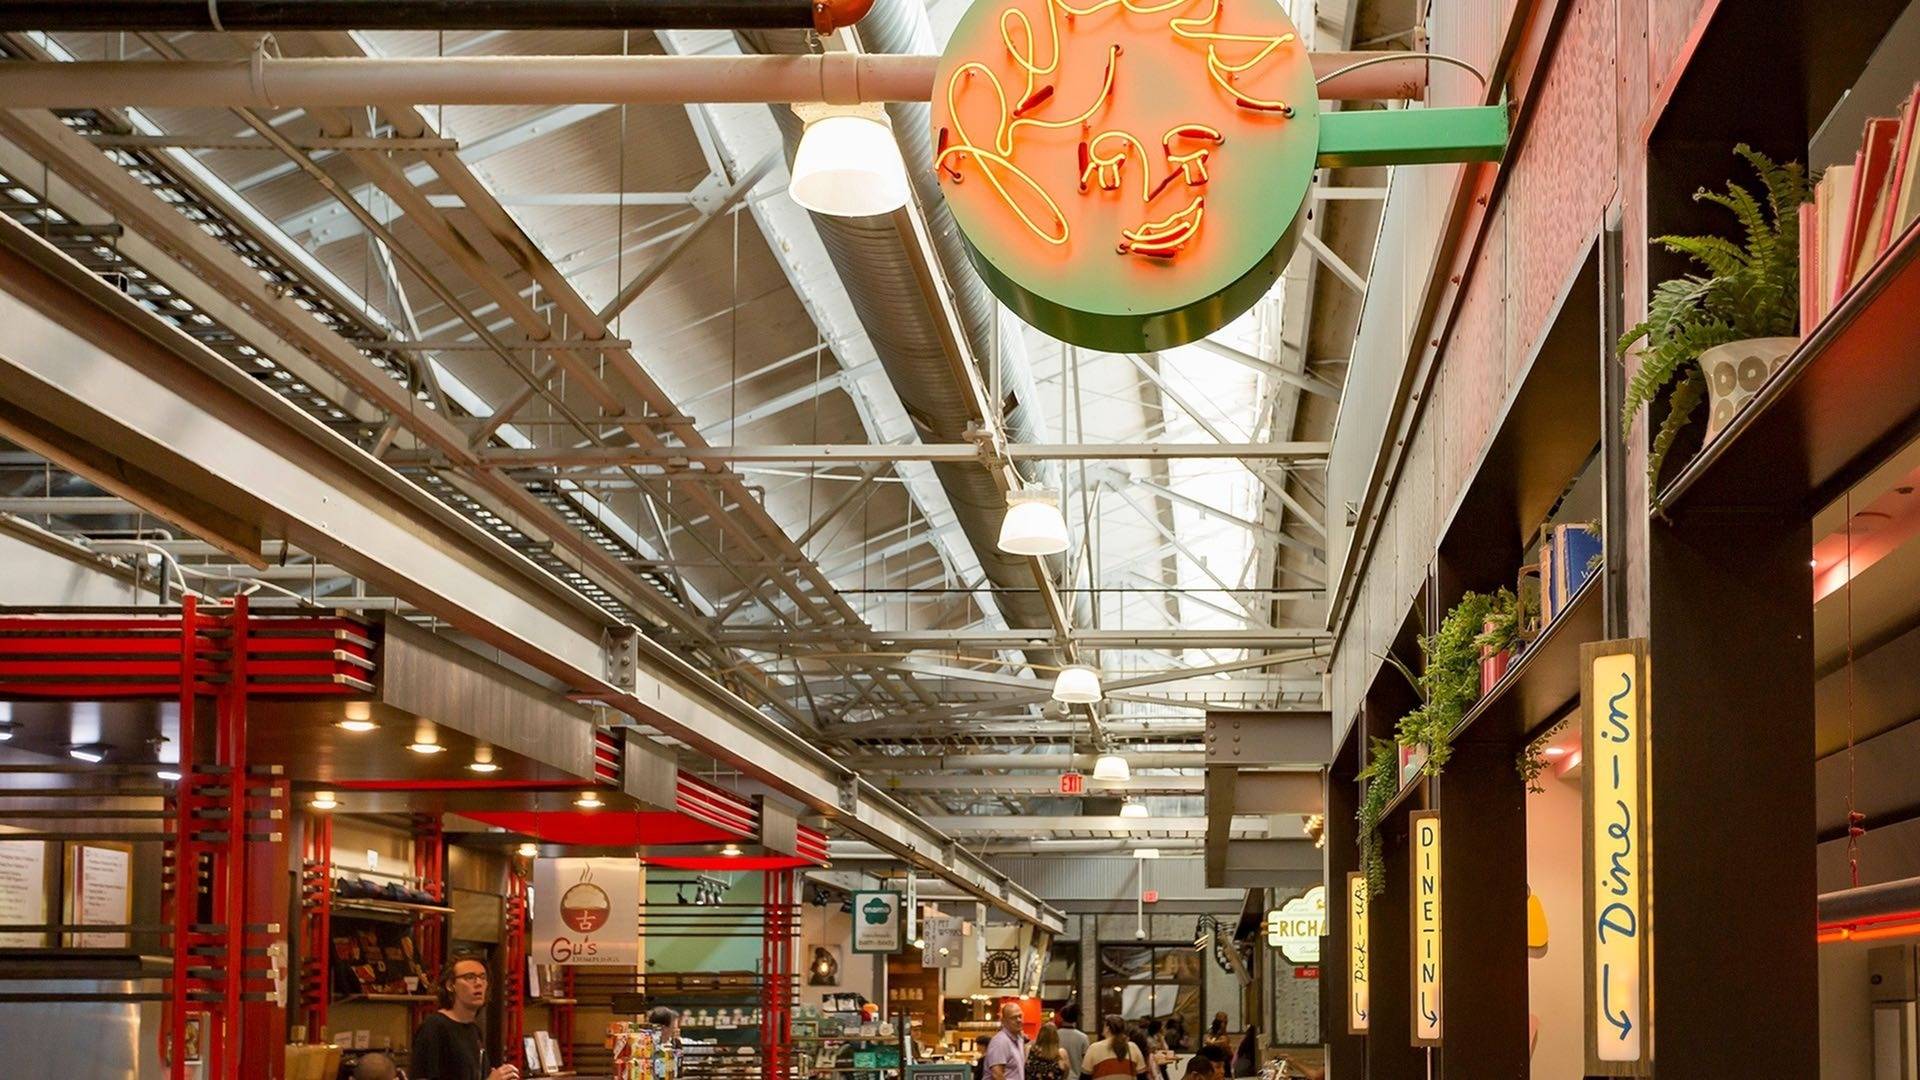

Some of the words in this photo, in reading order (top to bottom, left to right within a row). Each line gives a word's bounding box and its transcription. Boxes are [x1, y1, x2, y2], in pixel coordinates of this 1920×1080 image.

[1062, 776, 1082, 792] EXIT
[1422, 826, 1435, 983] DINE-IN
[576, 910, 597, 931] 古
[551, 935, 598, 963] Gu's
